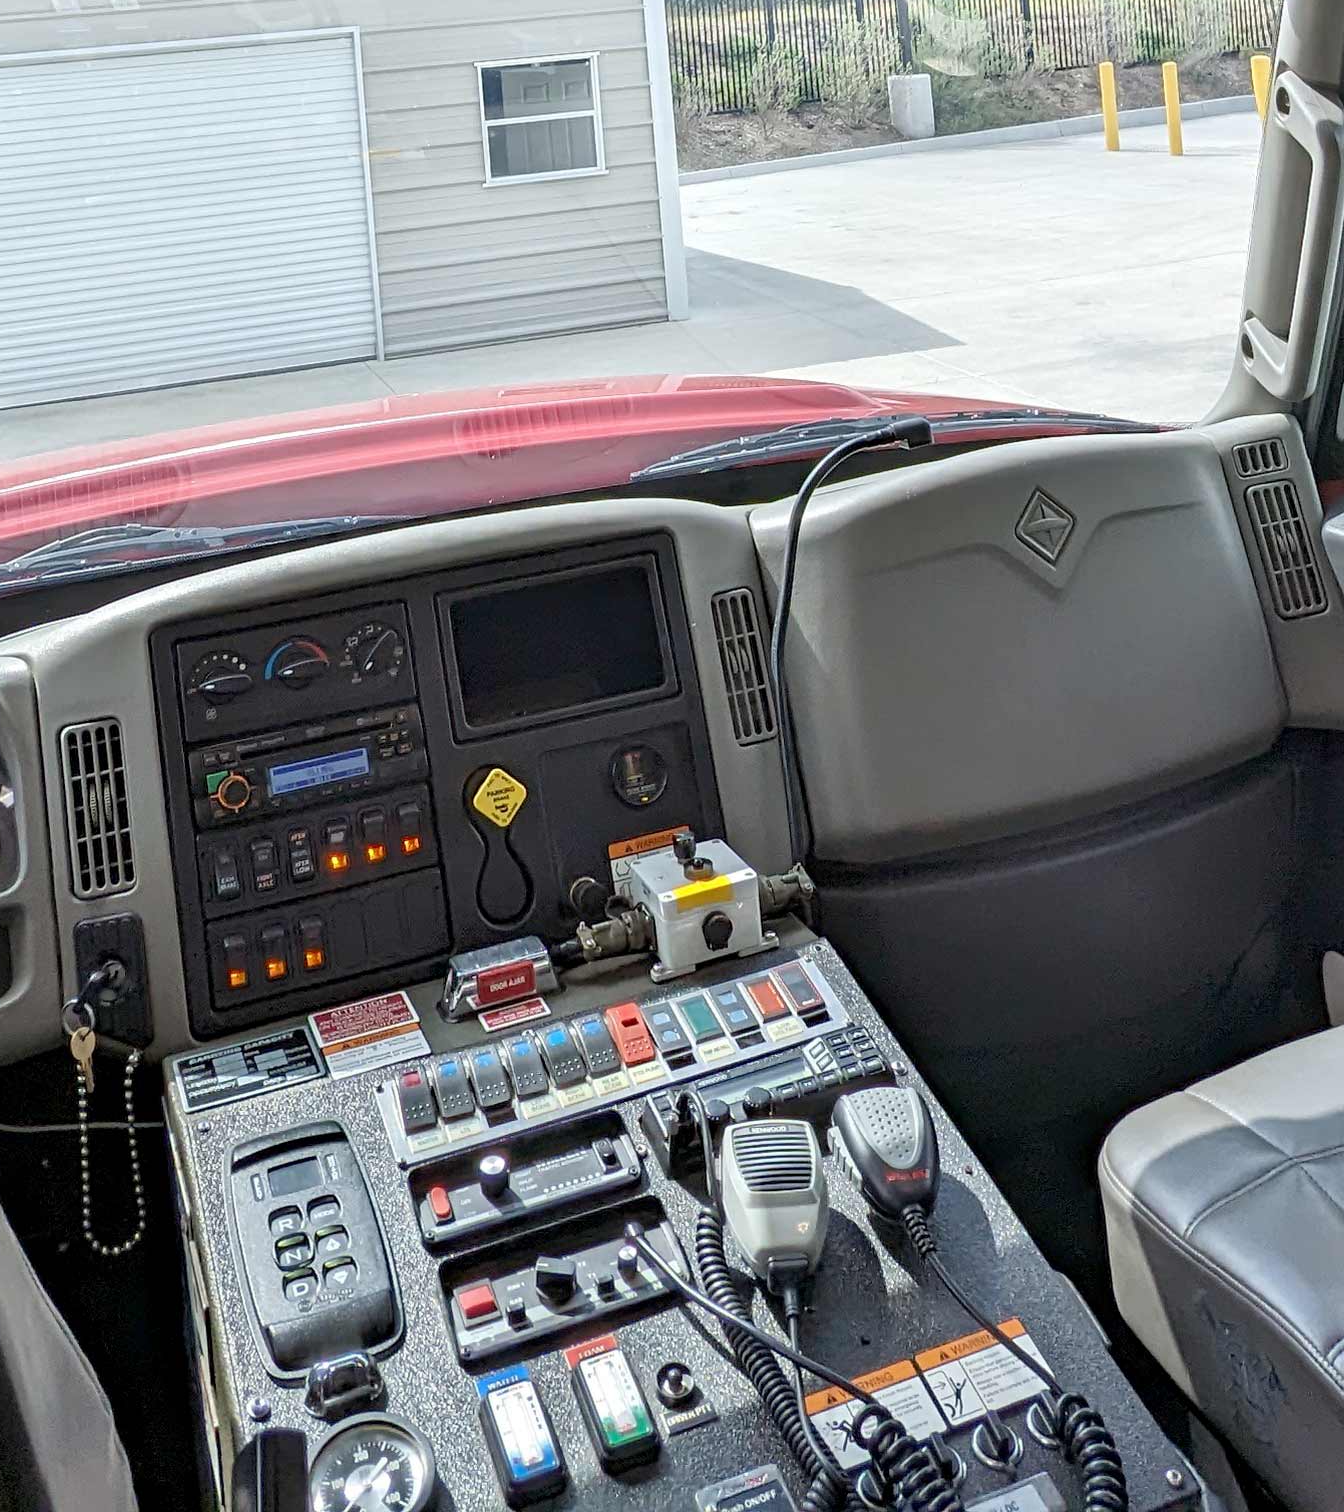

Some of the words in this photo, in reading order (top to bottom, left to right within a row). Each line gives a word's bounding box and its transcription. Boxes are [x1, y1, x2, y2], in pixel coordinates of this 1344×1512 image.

[278, 1218, 294, 1233] R
[285, 1248, 302, 1265] N
[292, 1282, 310, 1297] D
